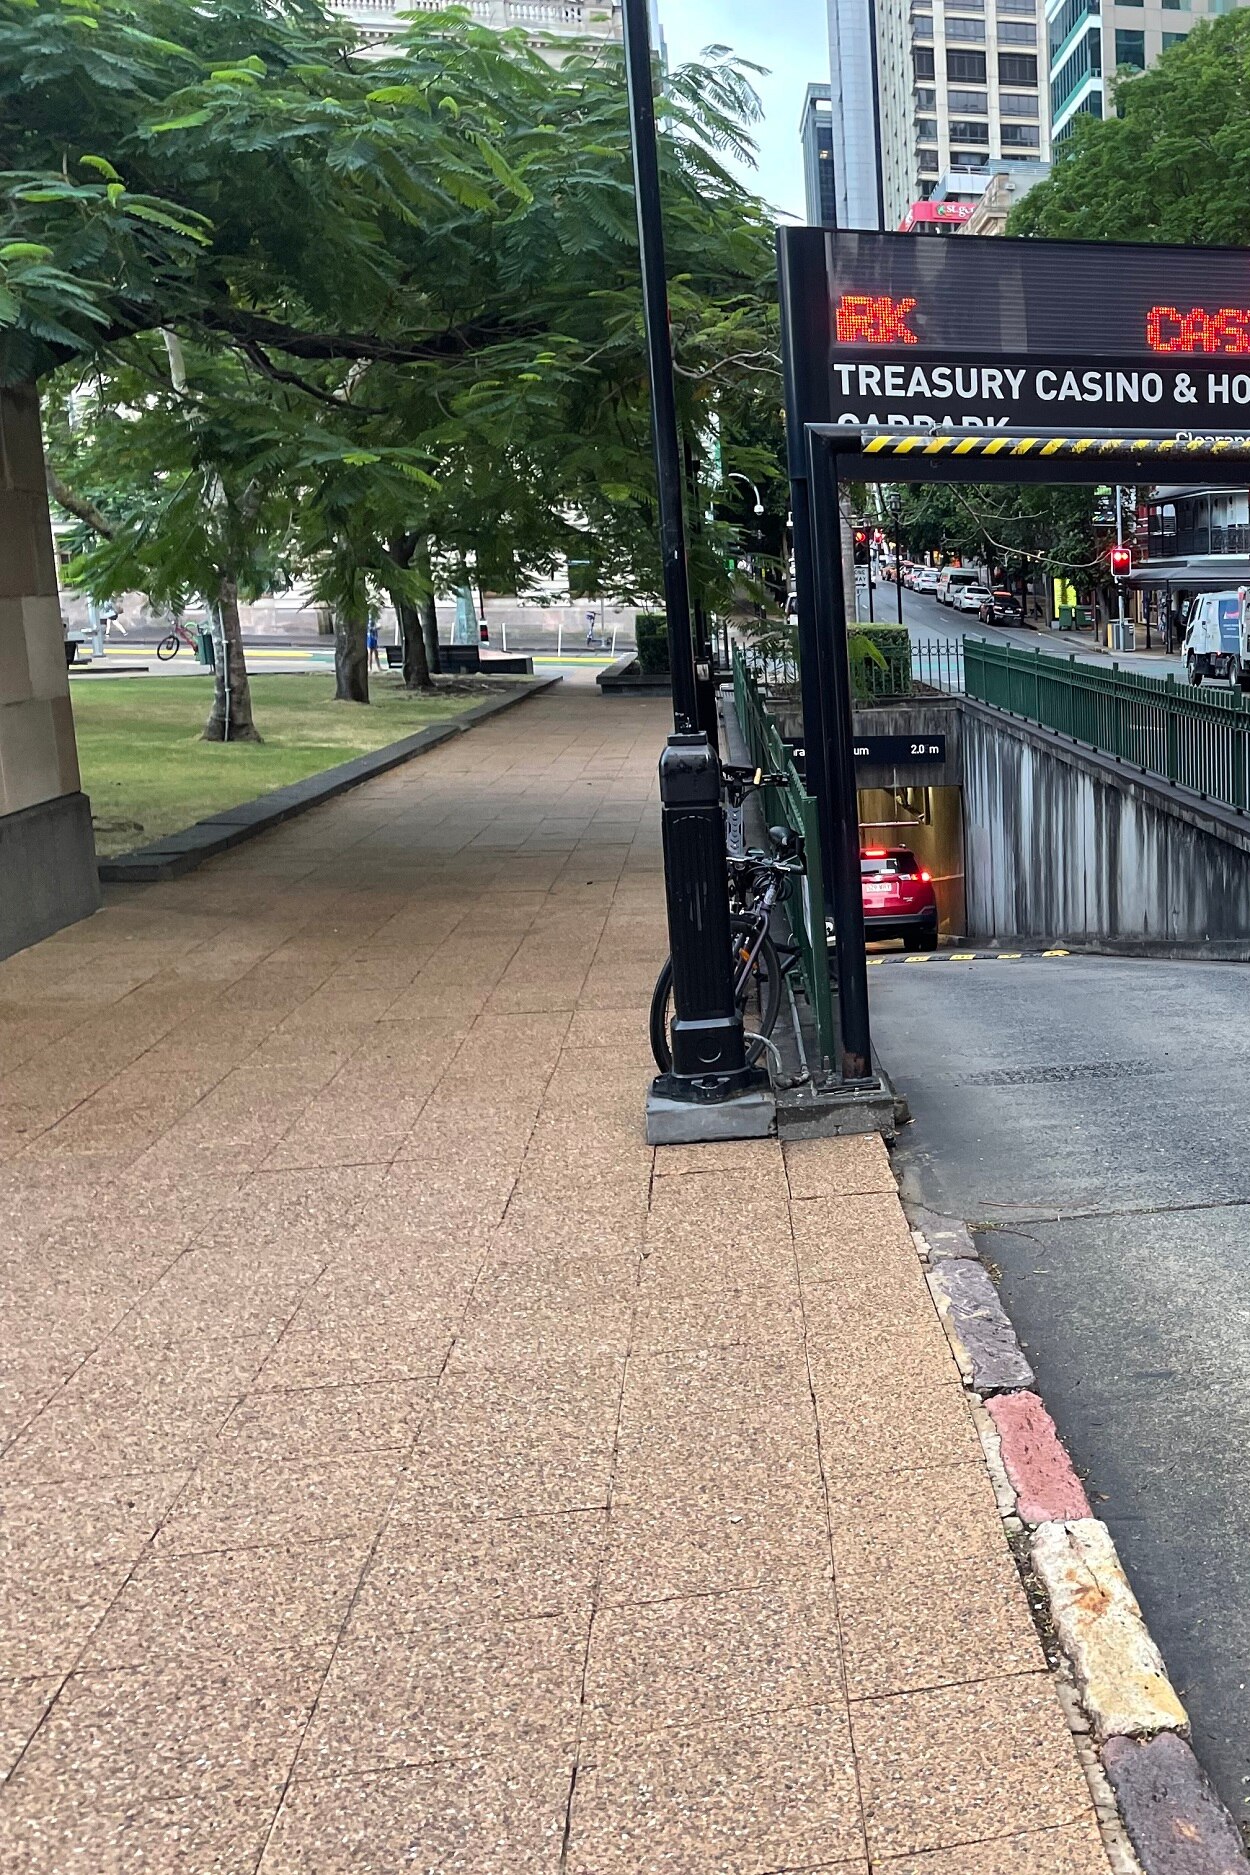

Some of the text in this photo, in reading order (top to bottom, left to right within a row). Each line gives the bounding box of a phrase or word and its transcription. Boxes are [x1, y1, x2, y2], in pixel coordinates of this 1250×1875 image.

[833, 363, 1026, 400] TREASURY
[1035, 369, 1163, 403] CASINO
[1173, 373, 1198, 404] &
[911, 744, 940, 754] 2.0 m
